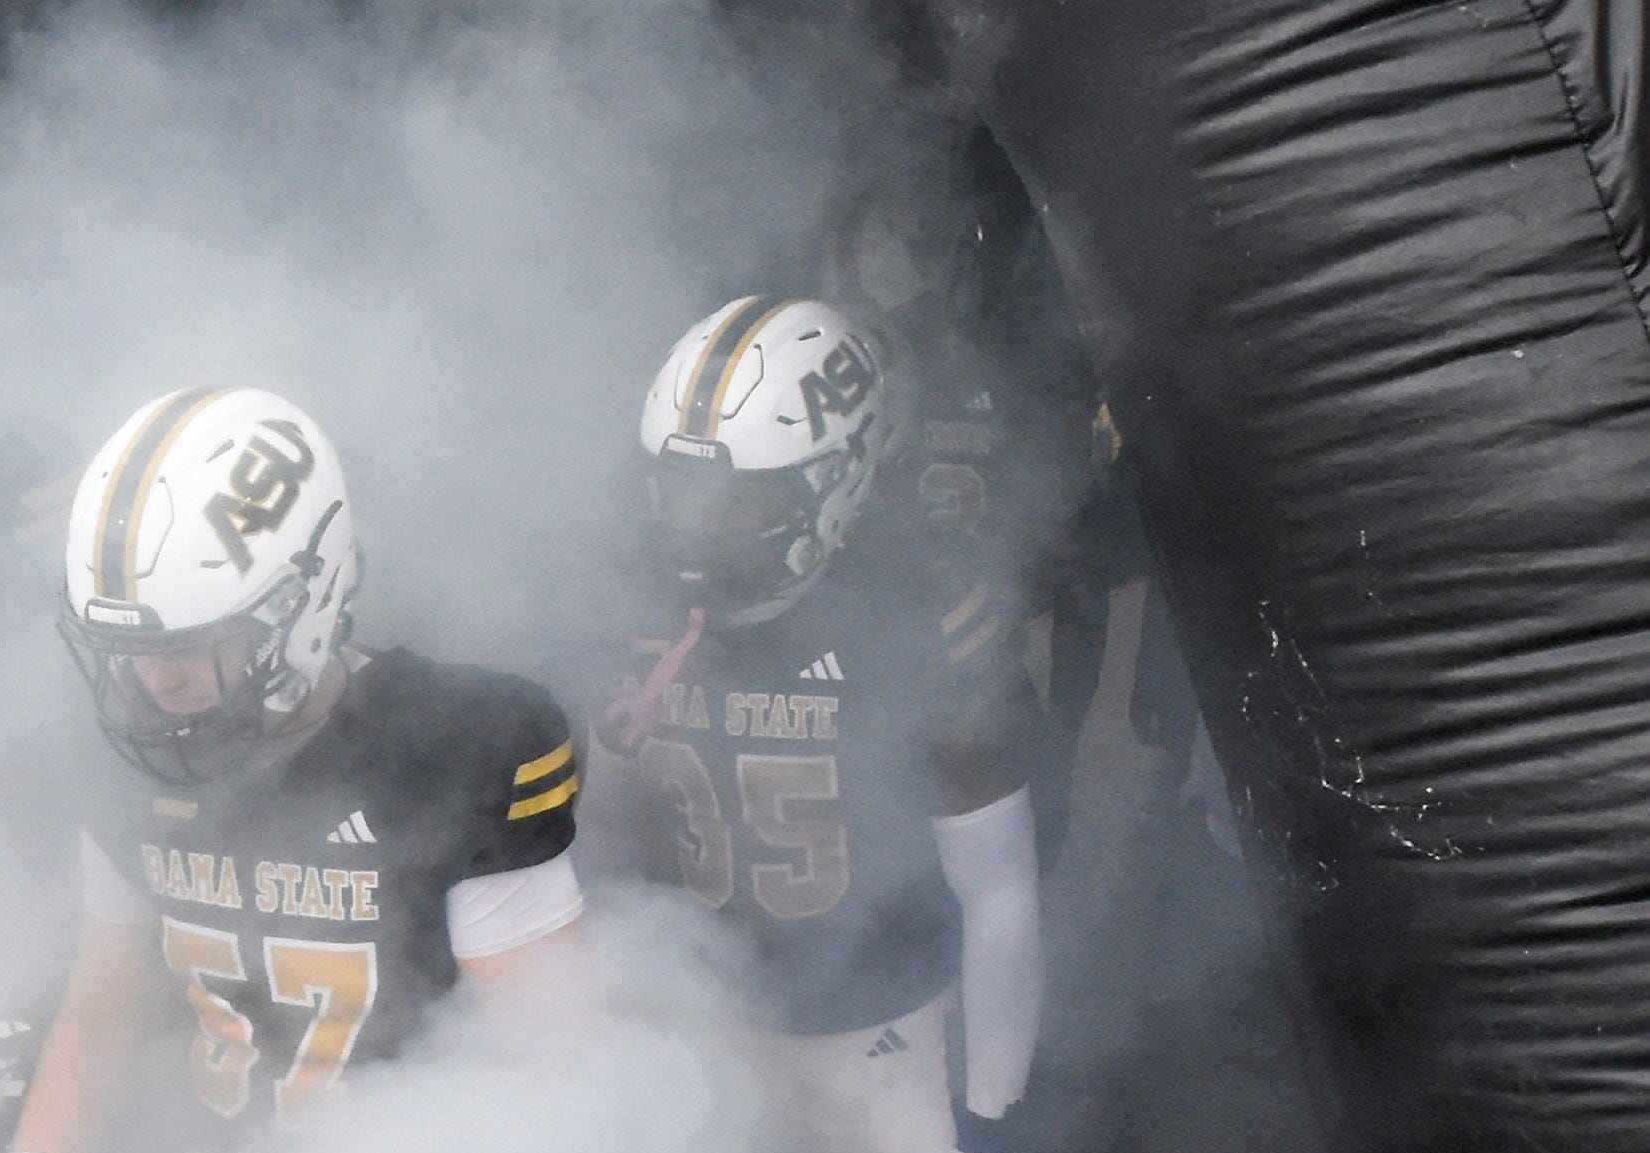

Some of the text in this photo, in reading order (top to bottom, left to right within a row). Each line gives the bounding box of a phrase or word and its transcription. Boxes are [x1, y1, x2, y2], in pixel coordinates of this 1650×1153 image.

[203, 419, 315, 579] ASU
[725, 692, 840, 740] STATE
[254, 861, 380, 921] STATE
[161, 914, 379, 1132] 57
